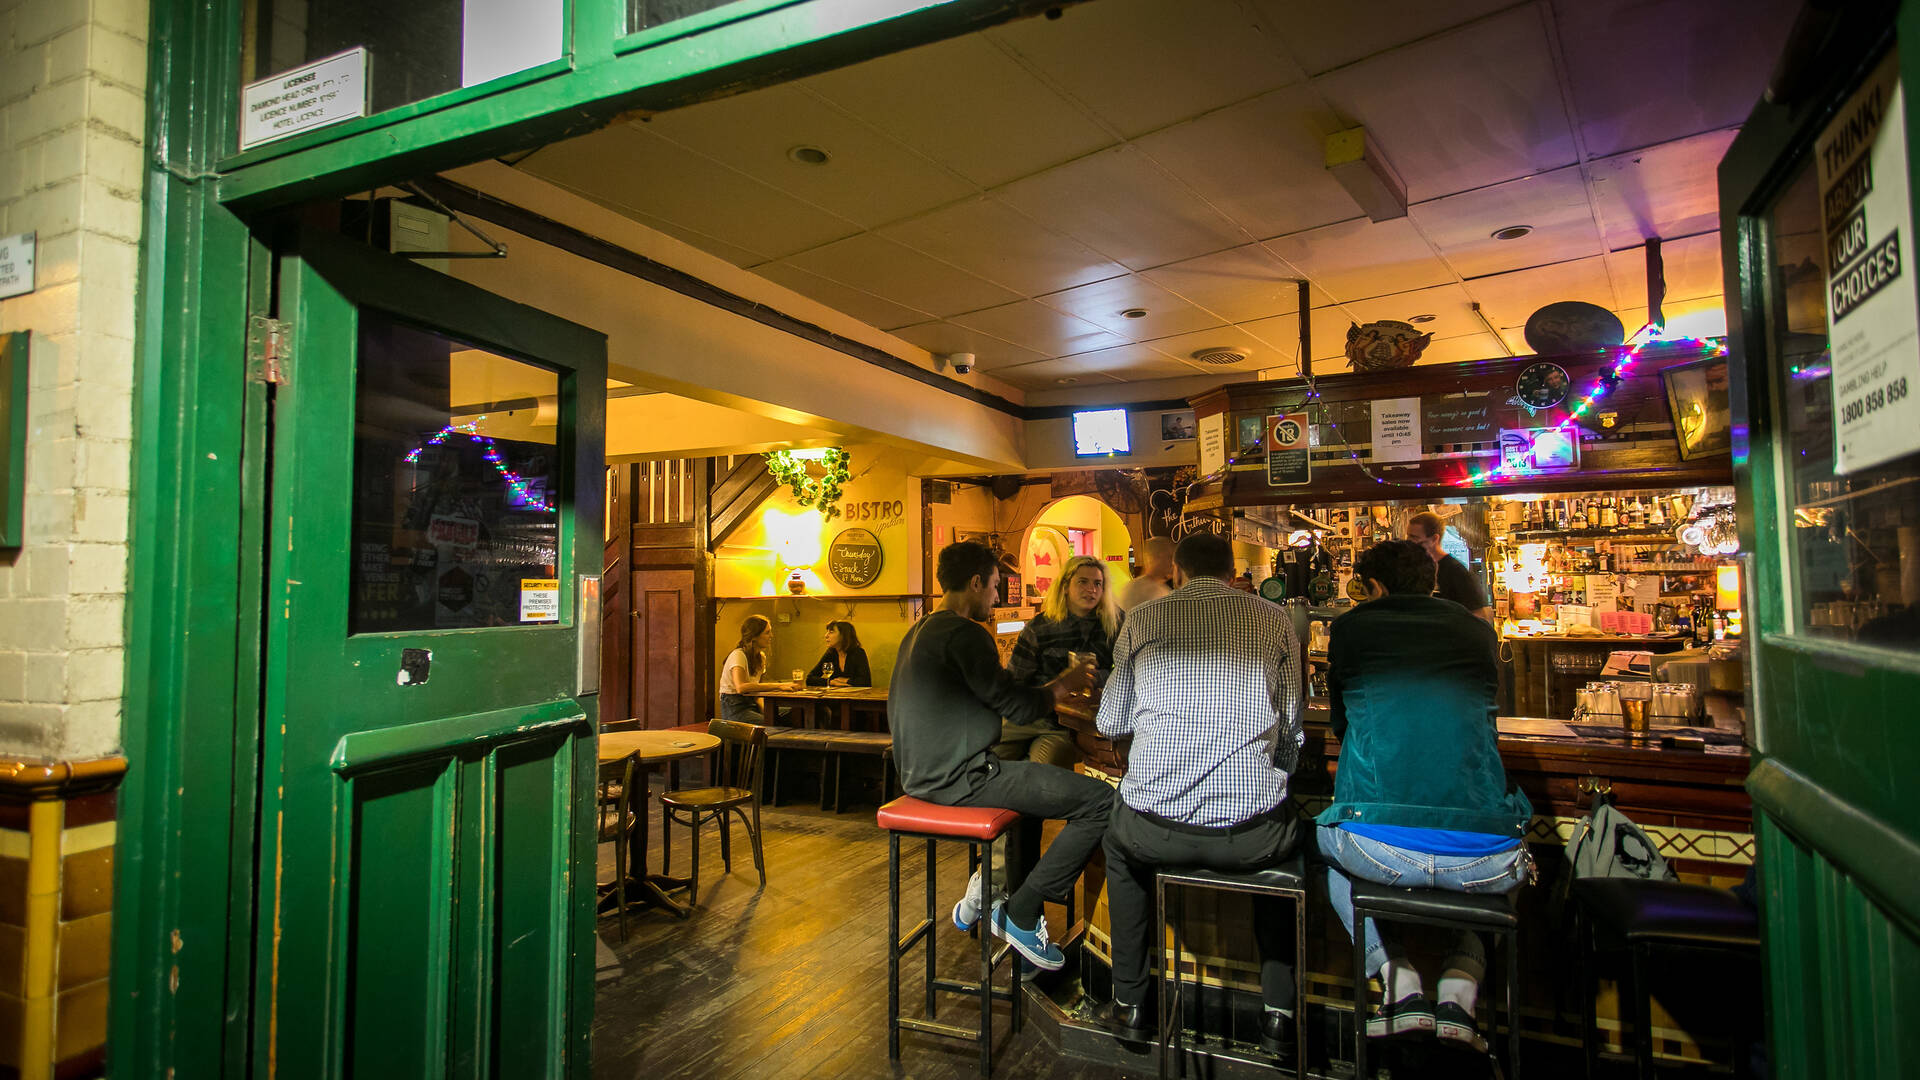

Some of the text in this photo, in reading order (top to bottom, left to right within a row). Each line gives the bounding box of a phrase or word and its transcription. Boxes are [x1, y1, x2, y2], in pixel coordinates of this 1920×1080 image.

[283, 71, 317, 89] LICENSEE
[250, 96, 281, 112] DIAMOND
[281, 90, 300, 101] HEAD
[260, 106, 288, 122] LICENCE
[289, 97, 318, 112] NUMBER
[272, 107, 325, 130] HOTEL LICENCE
[1822, 83, 1882, 180] THINK!
[1826, 157, 1871, 220] ABOUT
[1829, 213, 1866, 270] YOUR
[1832, 239, 1899, 317] CHOICES
[1839, 360, 1888, 398] GAMBLING HELP
[1841, 376, 1908, 425] 1800 858 858
[1279, 428, 1296, 442] 18
[845, 500, 904, 520] BISTRO
[1161, 507, 1179, 528] the
[837, 547, 875, 566] Thursday
[839, 561, 861, 573] Snack
